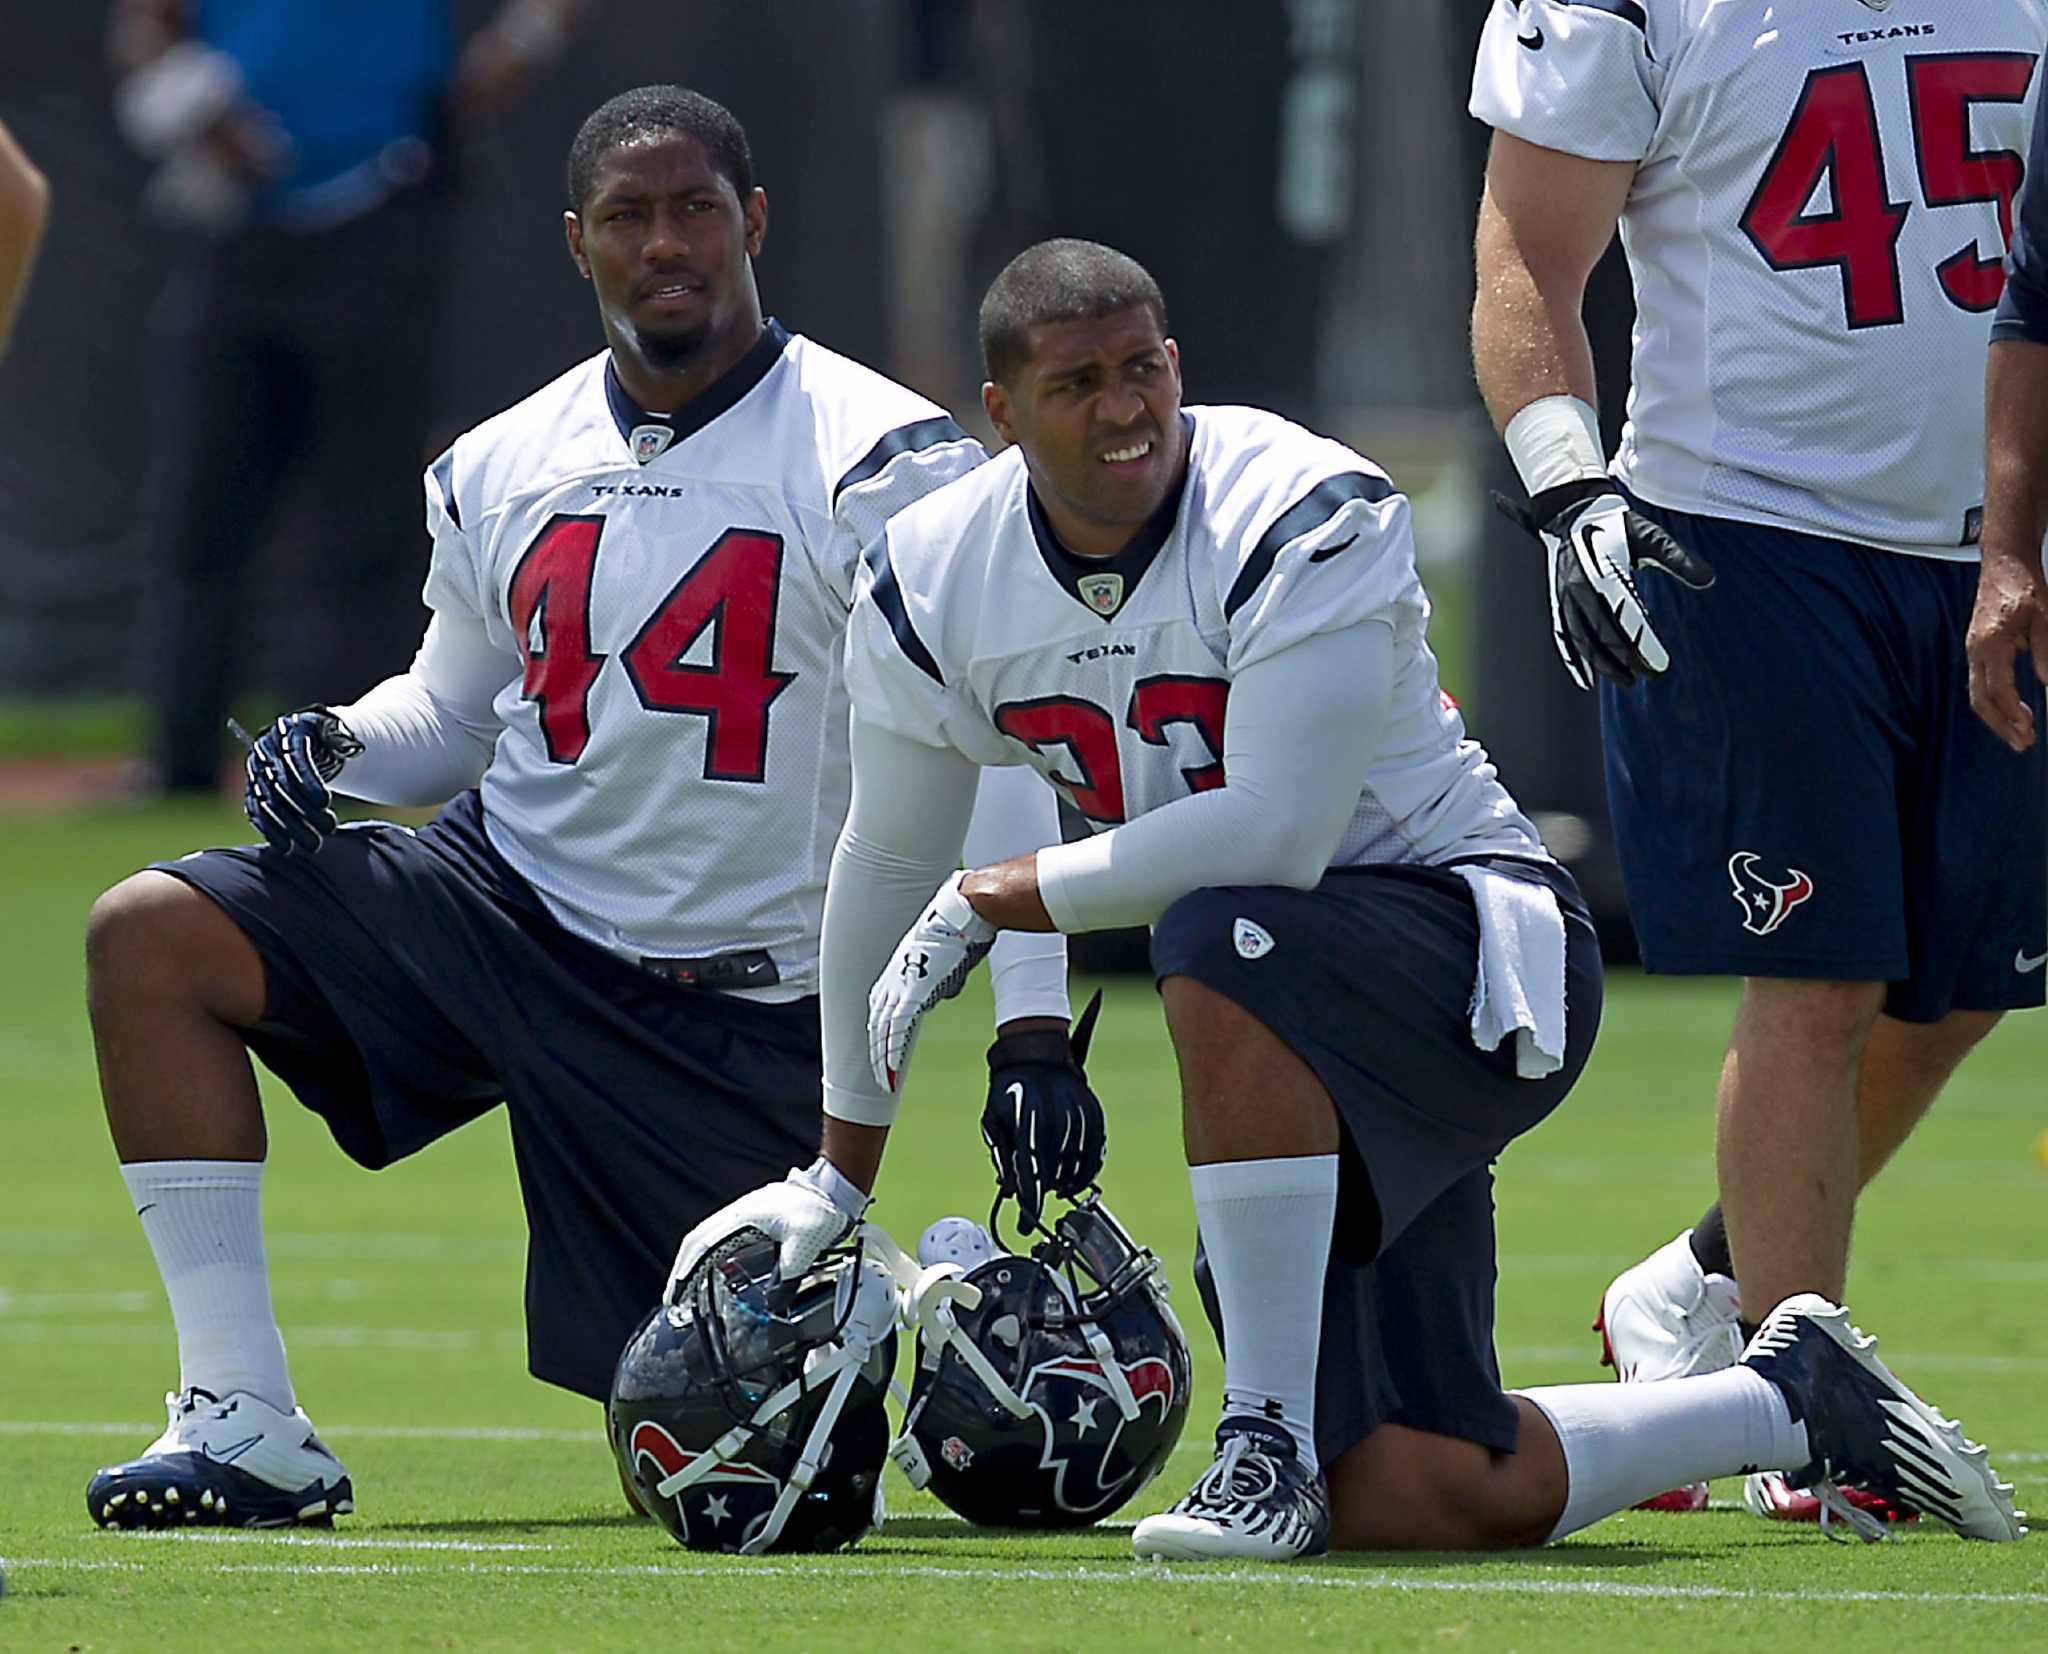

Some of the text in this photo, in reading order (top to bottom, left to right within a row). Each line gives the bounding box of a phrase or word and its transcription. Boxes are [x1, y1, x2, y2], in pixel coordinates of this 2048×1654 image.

[1837, 24, 1935, 45] TEXANS
[1738, 51, 2039, 330] 45
[506, 513, 798, 783] 44
